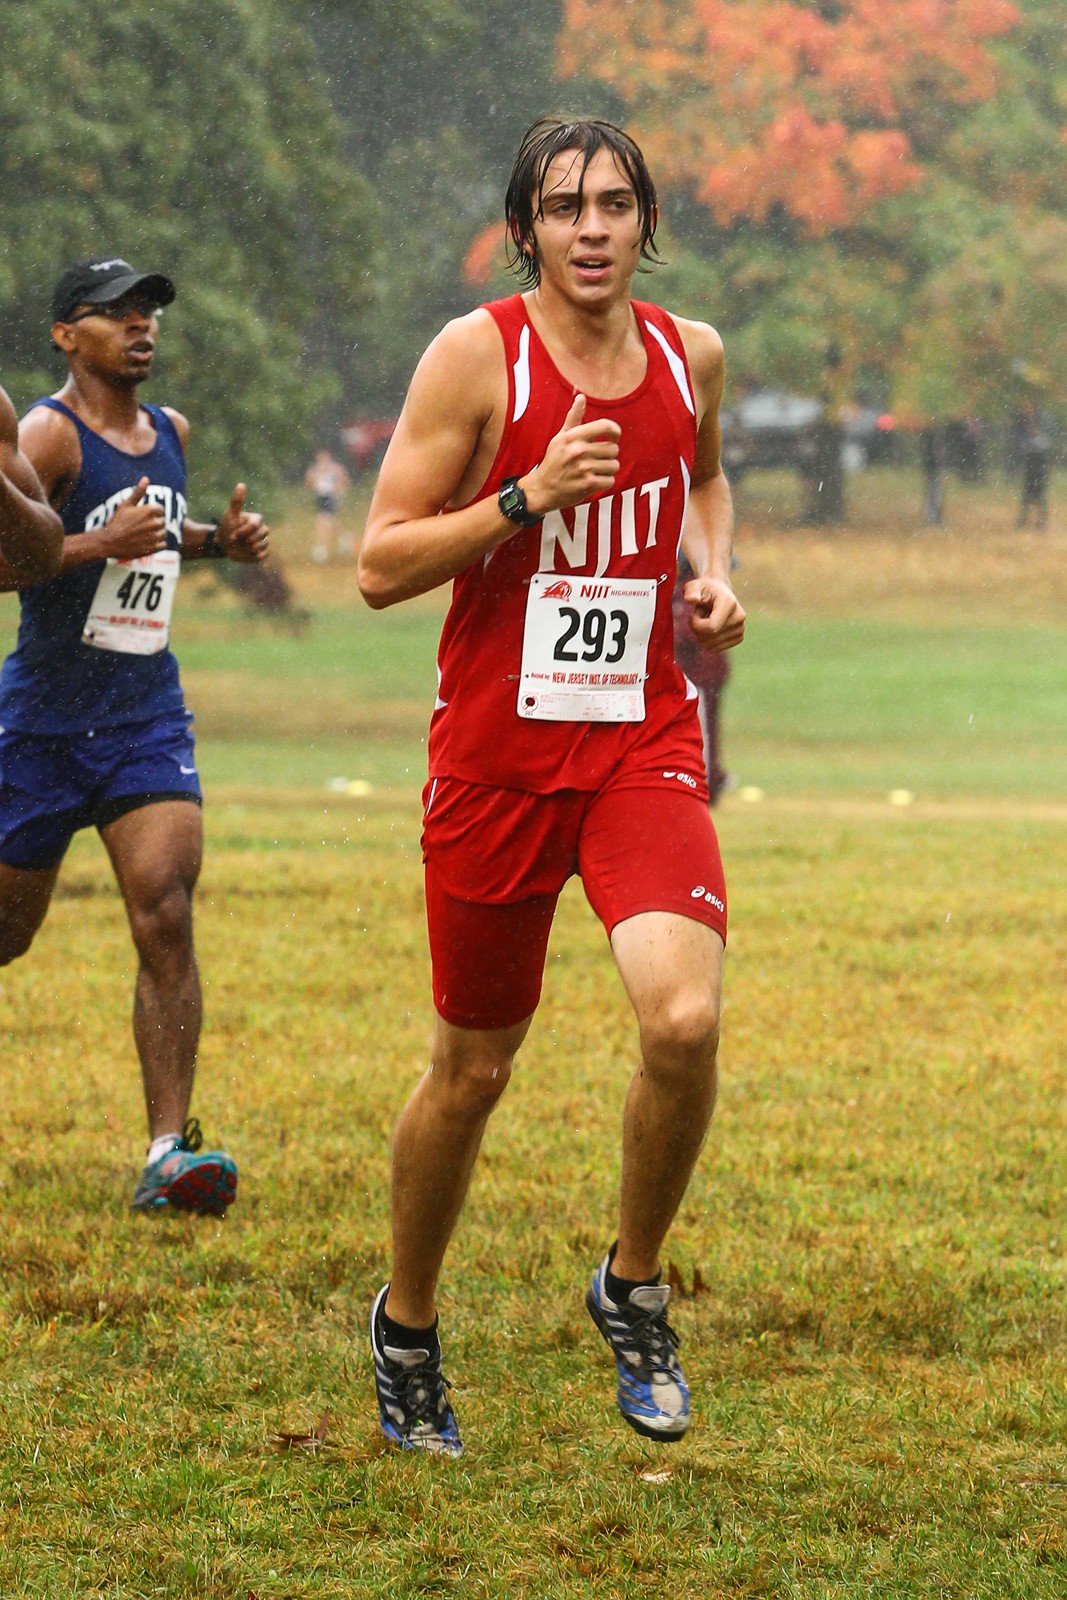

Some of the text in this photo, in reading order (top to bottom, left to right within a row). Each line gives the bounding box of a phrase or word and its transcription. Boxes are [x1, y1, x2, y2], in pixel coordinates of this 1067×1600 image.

[538, 476, 670, 578] NJIT
[117, 571, 164, 611] 476
[580, 584, 611, 602] NJIT
[553, 606, 629, 663] 293
[552, 672, 566, 683] NEW
[567, 672, 588, 685] JERSEY
[602, 673, 608, 685] OF
[609, 673, 639, 685] TECHNOLOGY
[677, 773, 697, 788] asics
[704, 892, 724, 912] asics
